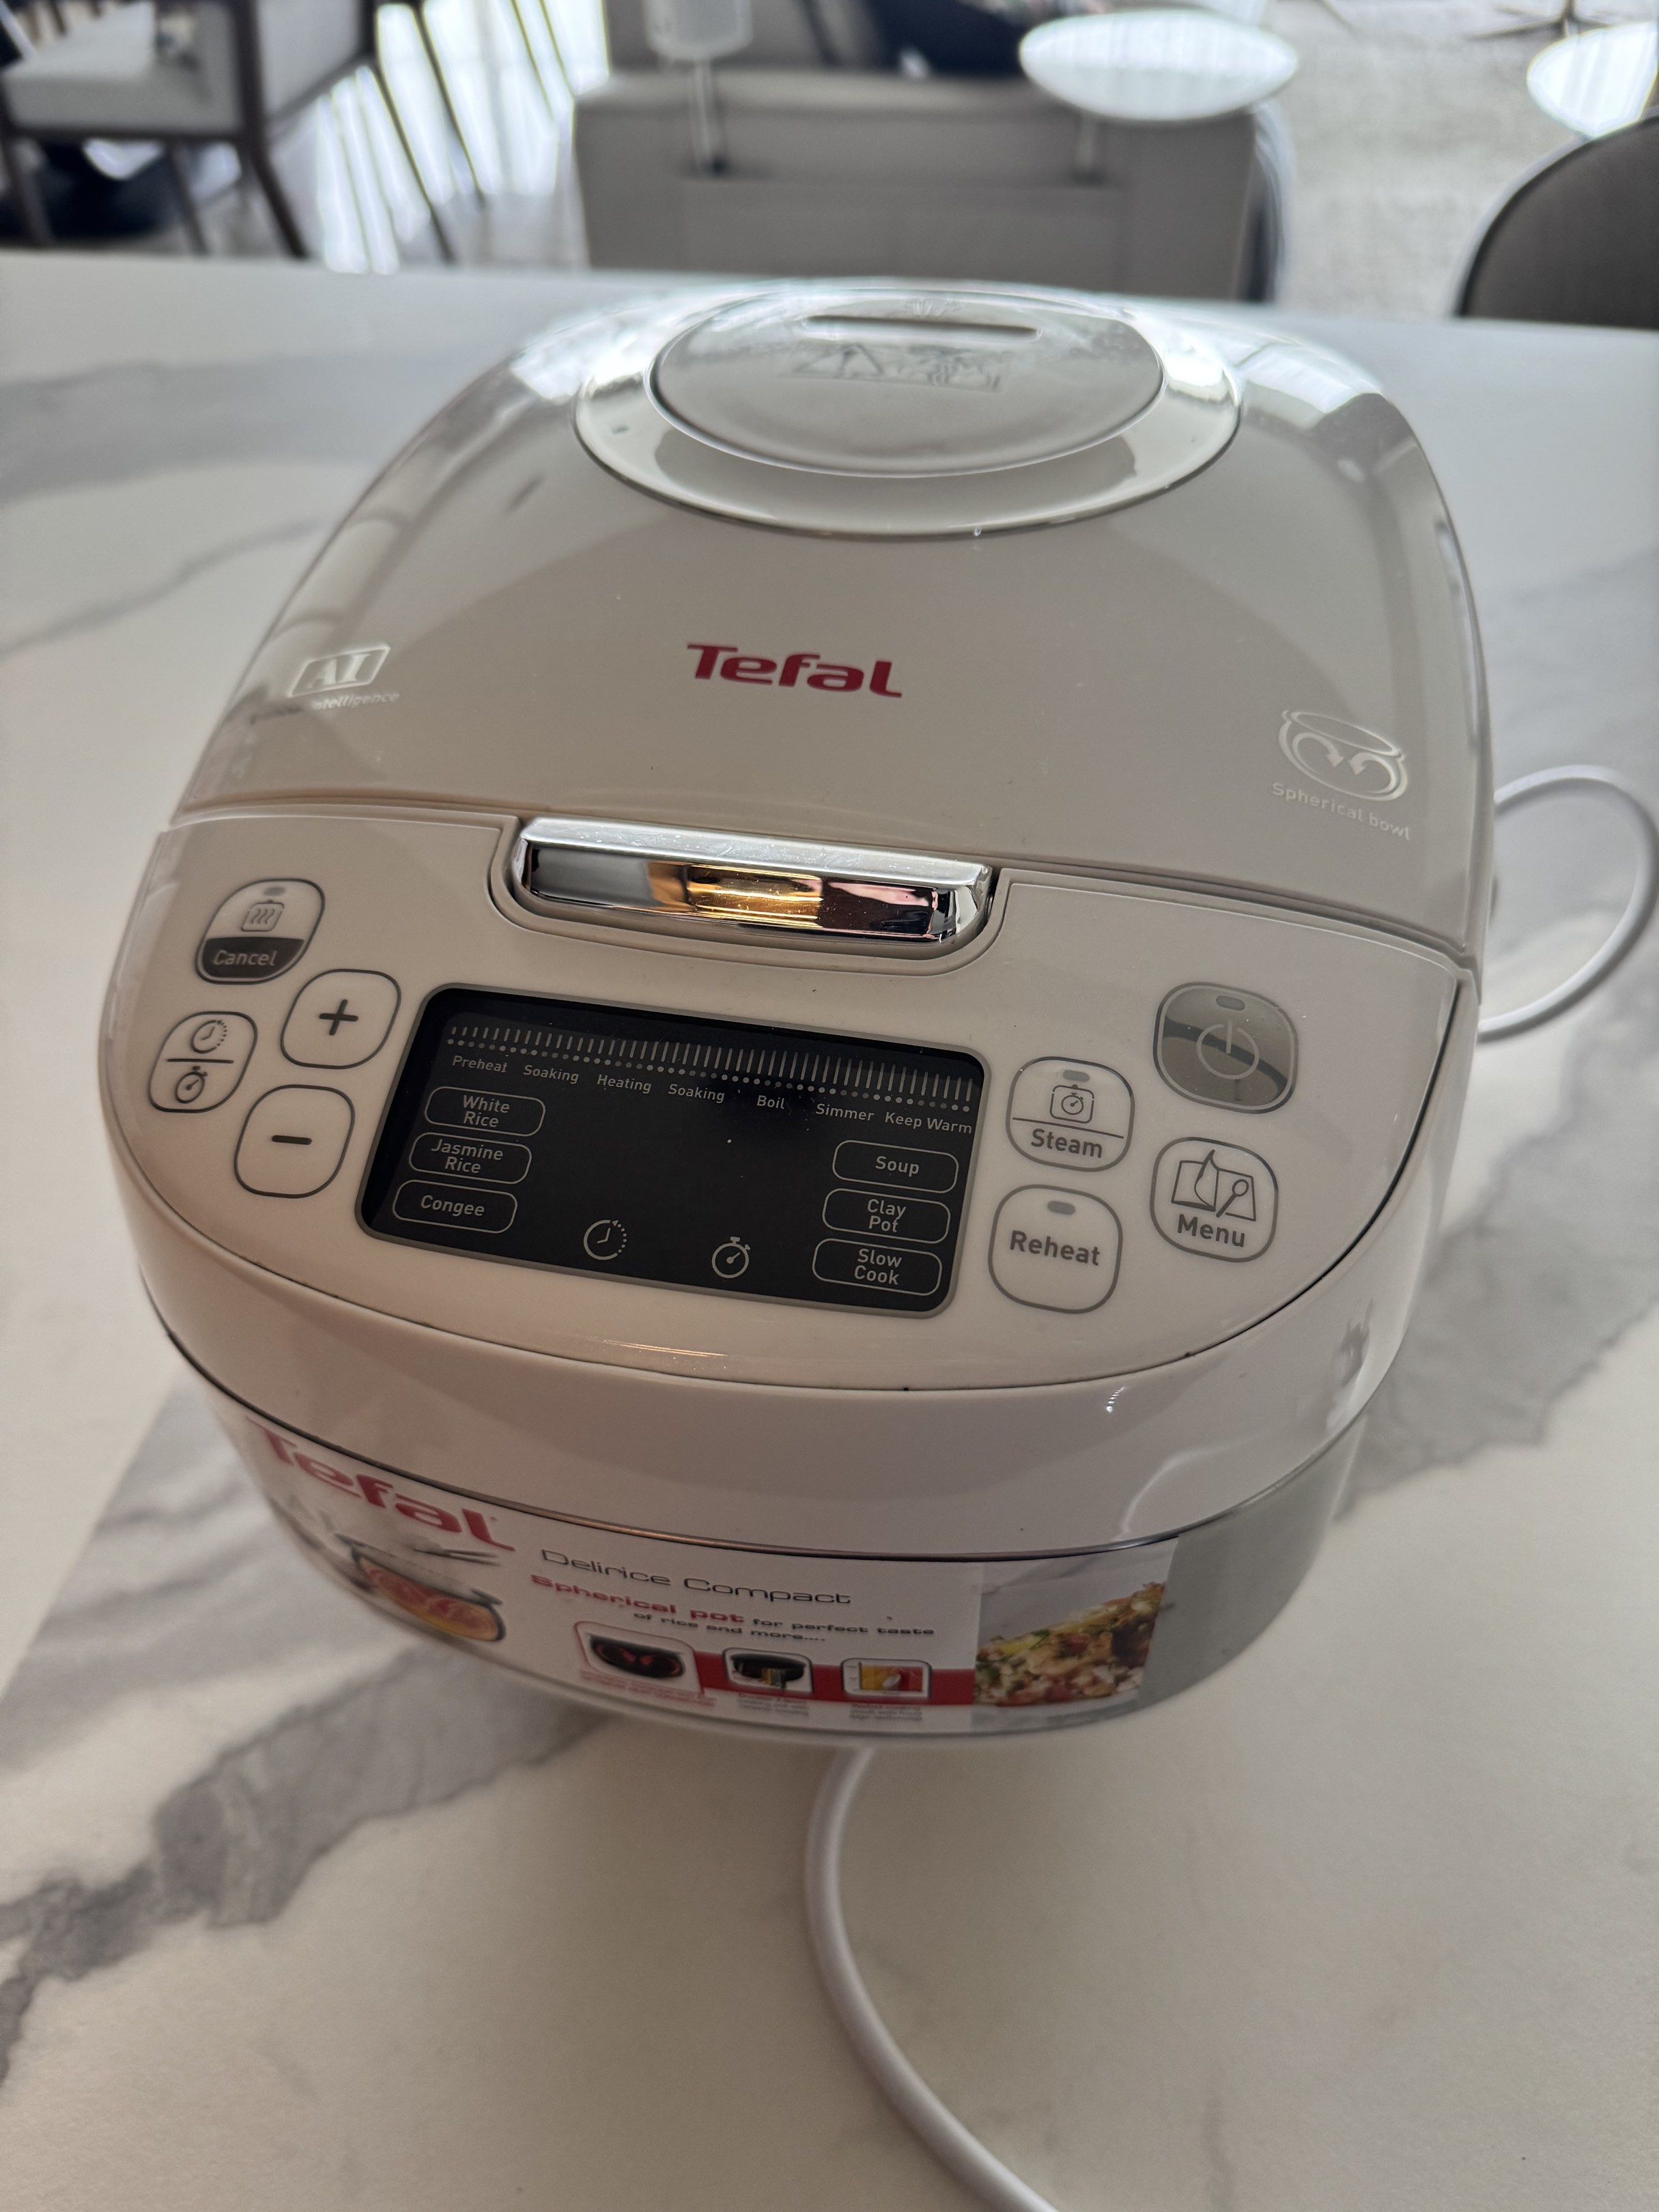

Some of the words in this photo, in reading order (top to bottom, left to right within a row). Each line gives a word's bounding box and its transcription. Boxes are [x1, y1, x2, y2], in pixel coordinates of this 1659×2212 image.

[305, 653, 371, 689] AI
[687, 644, 902, 698] Tefal
[1272, 782, 1362, 822] Spherical
[1369, 812, 1410, 840] bowl
[212, 949, 277, 967] Cancel
[453, 1055, 508, 1073] Preheat
[523, 1064, 579, 1084] Soaking
[597, 1074, 652, 1094] Heating
[668, 1083, 725, 1104] Soaking
[756, 1095, 784, 1110] Boil
[816, 1103, 875, 1122] Simmer
[885, 1111, 922, 1129] Keep
[926, 1118, 972, 1135] Warm
[462, 1094, 510, 1114] White
[463, 1111, 499, 1128] Rice
[431, 1139, 504, 1161] Jasmine
[1030, 1129, 1103, 1159] Steam
[444, 1156, 481, 1174] Rice
[875, 1156, 920, 1177] Soup
[421, 1195, 485, 1217] Congee
[867, 1199, 907, 1220] Clay
[868, 1215, 899, 1233] Pot
[1177, 1214, 1245, 1247] Menu
[857, 1248, 903, 1268] Slow
[1010, 1230, 1101, 1266] Reheat
[854, 1265, 900, 1286] Cook
[246, 1415, 515, 1552] Tefal
[541, 1549, 671, 1586] Delirice
[684, 1578, 851, 1604] Compact
[530, 1574, 677, 1614] Spherical
[690, 1609, 744, 1623] pot
[753, 1618, 783, 1626] for
[792, 1623, 868, 1634] perfect
[877, 1627, 935, 1635] taste
[634, 1613, 651, 1621] of
[661, 1617, 698, 1628] rice
[706, 1625, 743, 1634] and
